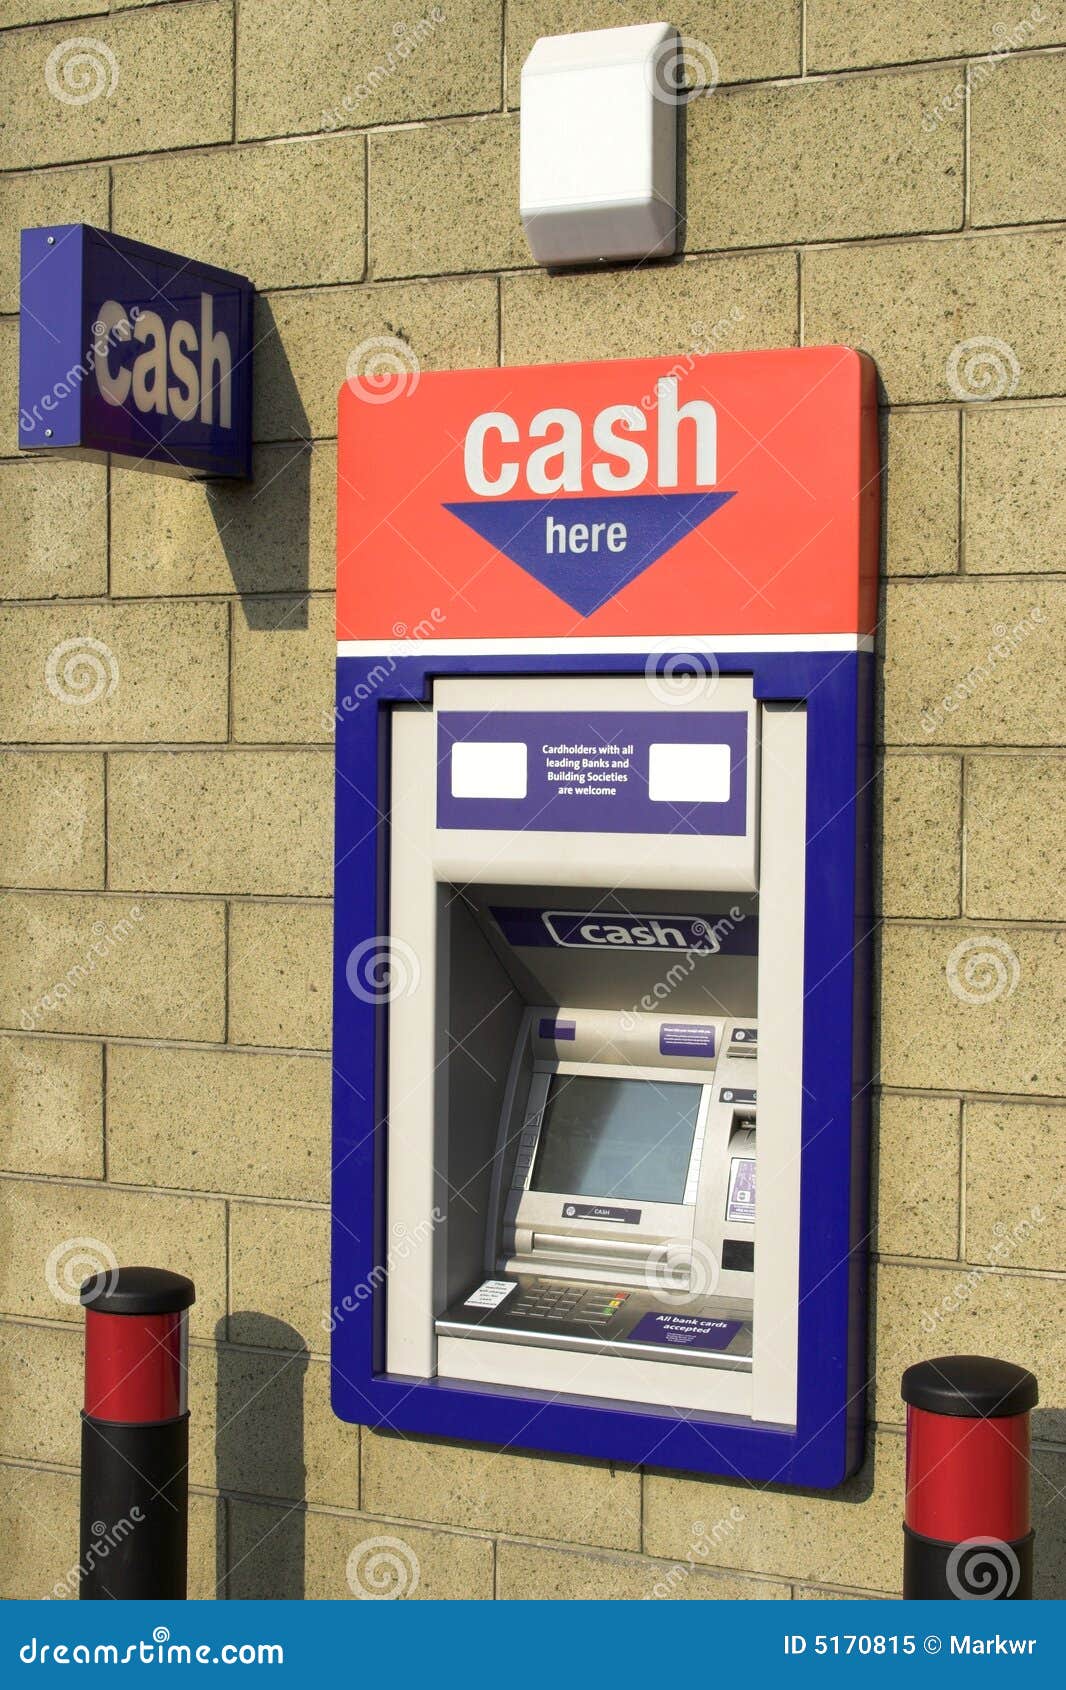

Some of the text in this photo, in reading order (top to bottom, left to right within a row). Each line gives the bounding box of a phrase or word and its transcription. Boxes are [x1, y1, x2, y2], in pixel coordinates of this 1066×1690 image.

[95, 291, 232, 429] cash
[464, 375, 717, 497] cash
[546, 516, 628, 554] here
[542, 744, 634, 755] Cardholders with all
[546, 758, 630, 770] leading Banks and
[547, 771, 628, 784] Building Societies
[558, 786, 617, 795] are welcome
[580, 920, 688, 947] cash
[594, 1208, 610, 1216] CASH
[663, 1324, 712, 1334] accepted
[672, 1316, 699, 1326] bank
[699, 1320, 728, 1329] cards
